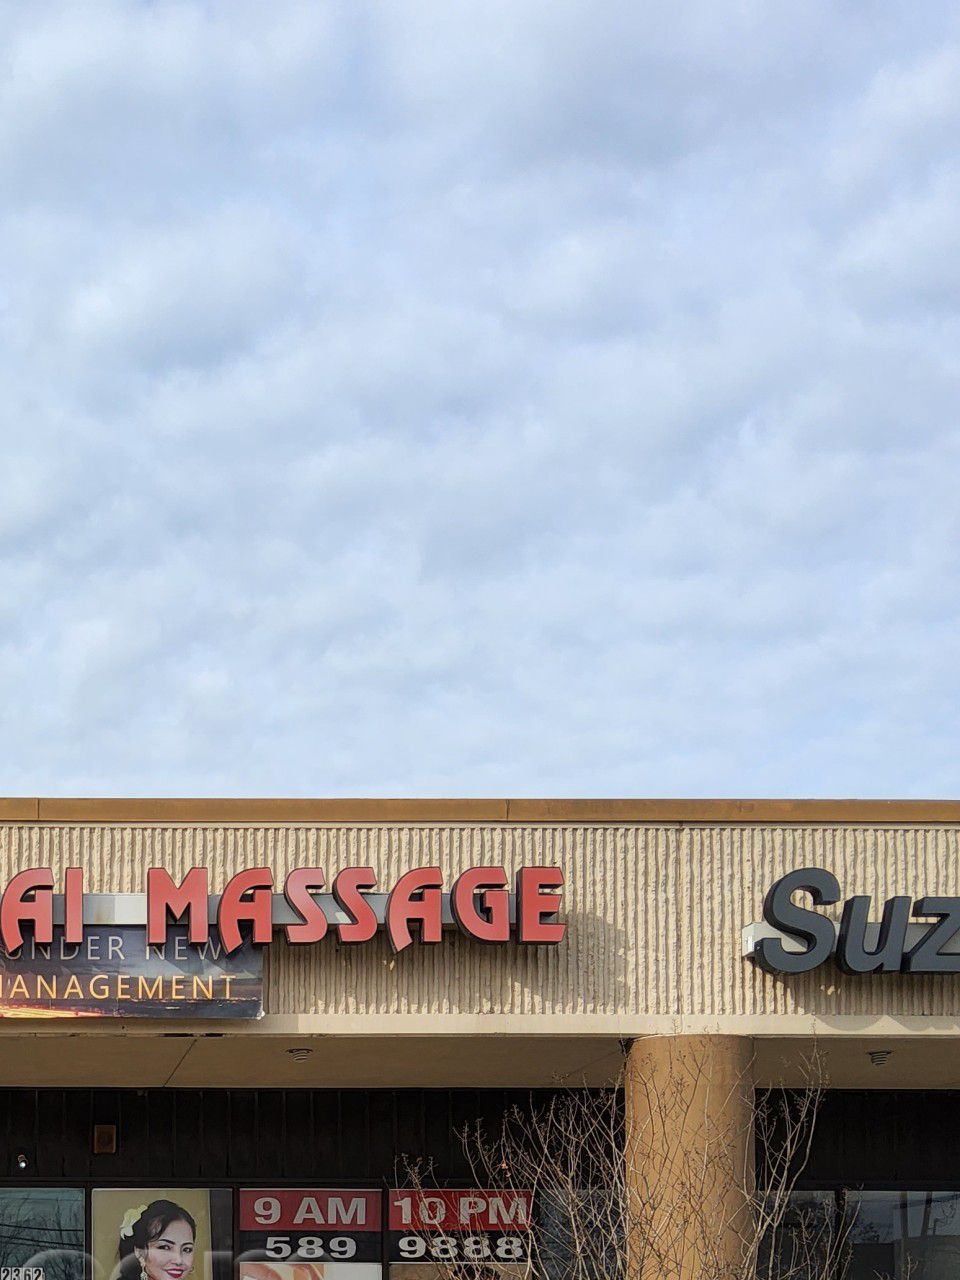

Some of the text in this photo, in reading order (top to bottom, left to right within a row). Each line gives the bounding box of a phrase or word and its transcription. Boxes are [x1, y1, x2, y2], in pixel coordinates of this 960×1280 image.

[146, 865, 566, 956] MASSAGE
[254, 1196, 366, 1225] 9 AM
[393, 1197, 528, 1225] 10 PM
[265, 1236, 357, 1259] 589
[398, 1236, 524, 1259] 9888
